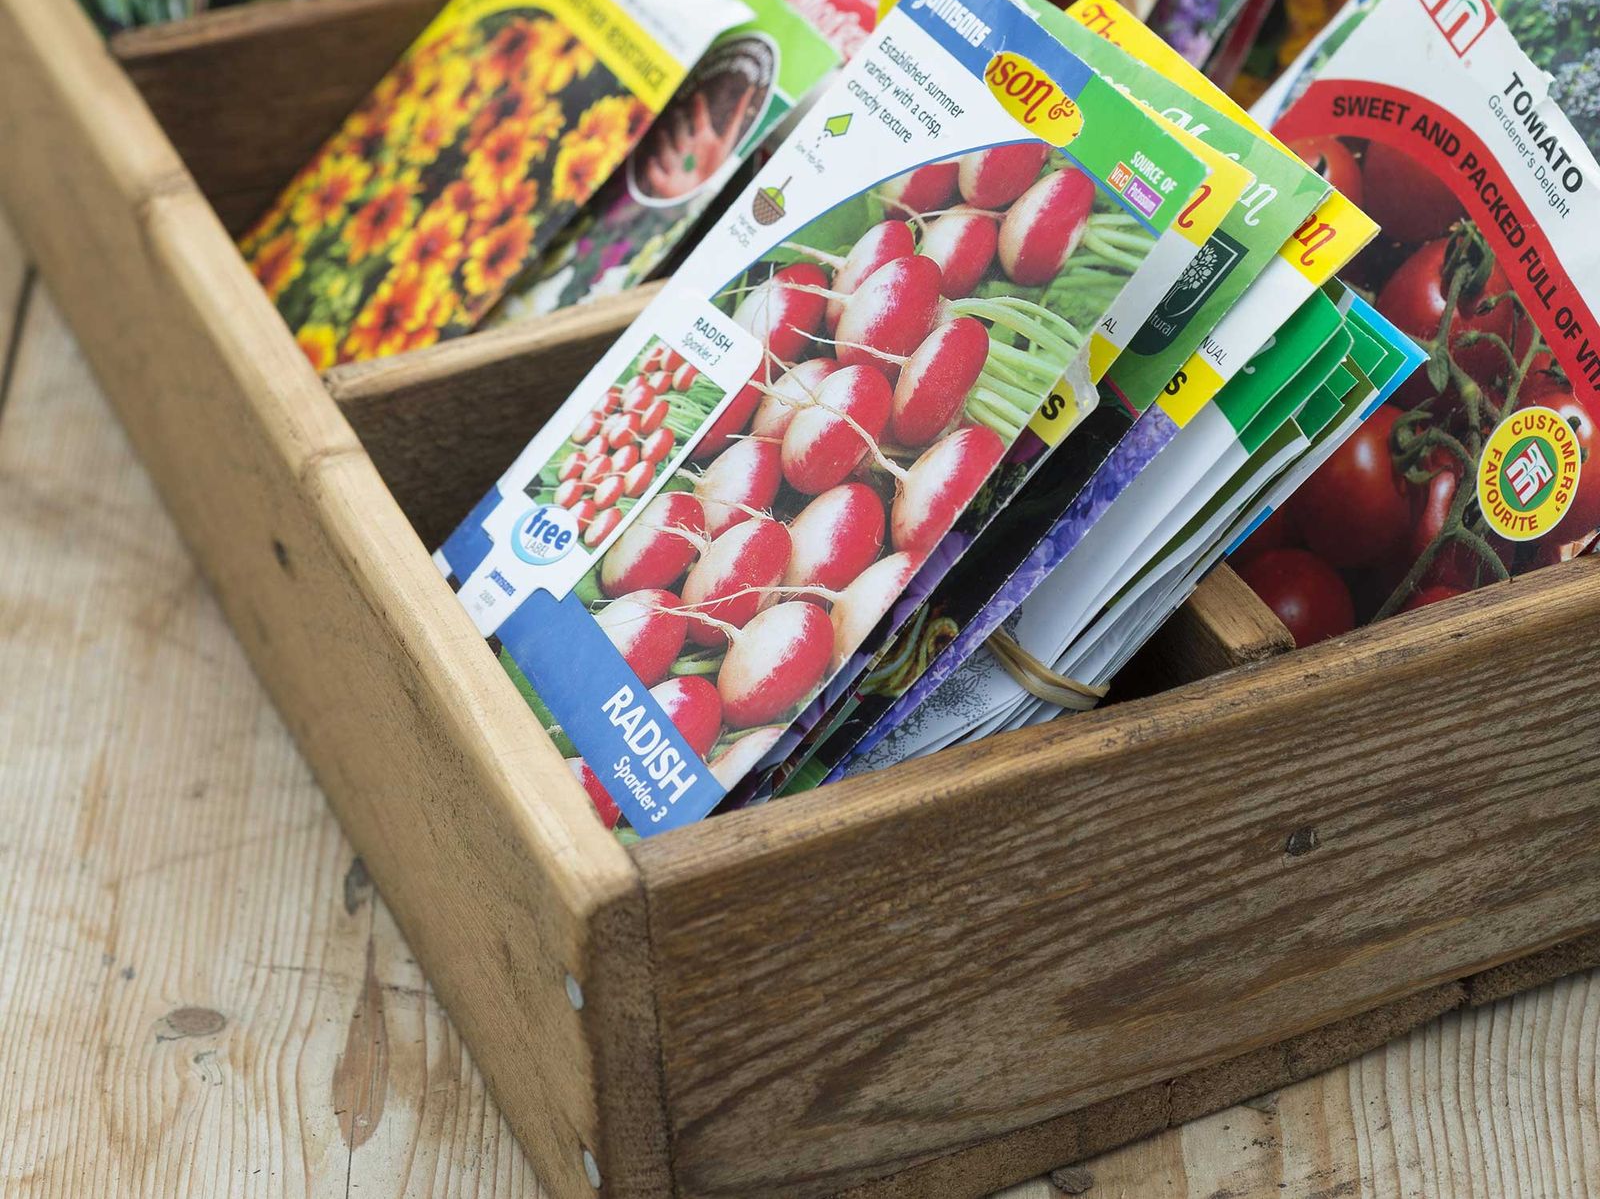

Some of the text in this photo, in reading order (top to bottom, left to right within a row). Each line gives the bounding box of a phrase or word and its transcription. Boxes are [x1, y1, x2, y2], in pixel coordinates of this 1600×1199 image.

[848, 79, 912, 143] crunchy texture
[863, 60, 942, 139] variety with a crisp,
[879, 36, 965, 118] Established summer
[1488, 94, 1571, 219] Gardener's Delight
[1503, 71, 1584, 194] TOMATO
[1130, 150, 1178, 194] SOURCE OF
[1331, 95, 1410, 126] SWEET
[1411, 114, 1461, 158] AND
[1458, 152, 1526, 249] PACKED
[1519, 246, 1557, 310] FULL
[1554, 306, 1582, 340] OF
[692, 317, 734, 352] RADISH
[709, 354, 721, 367] 3
[1101, 316, 1118, 335] AL
[1485, 448, 1538, 532] FAVOURITE
[1511, 414, 1576, 513] CUSTOMERS'
[524, 539, 549, 558] LABEL
[525, 507, 572, 550] free
[600, 684, 698, 805] RADISH
[613, 755, 668, 823] Sparkler 3
